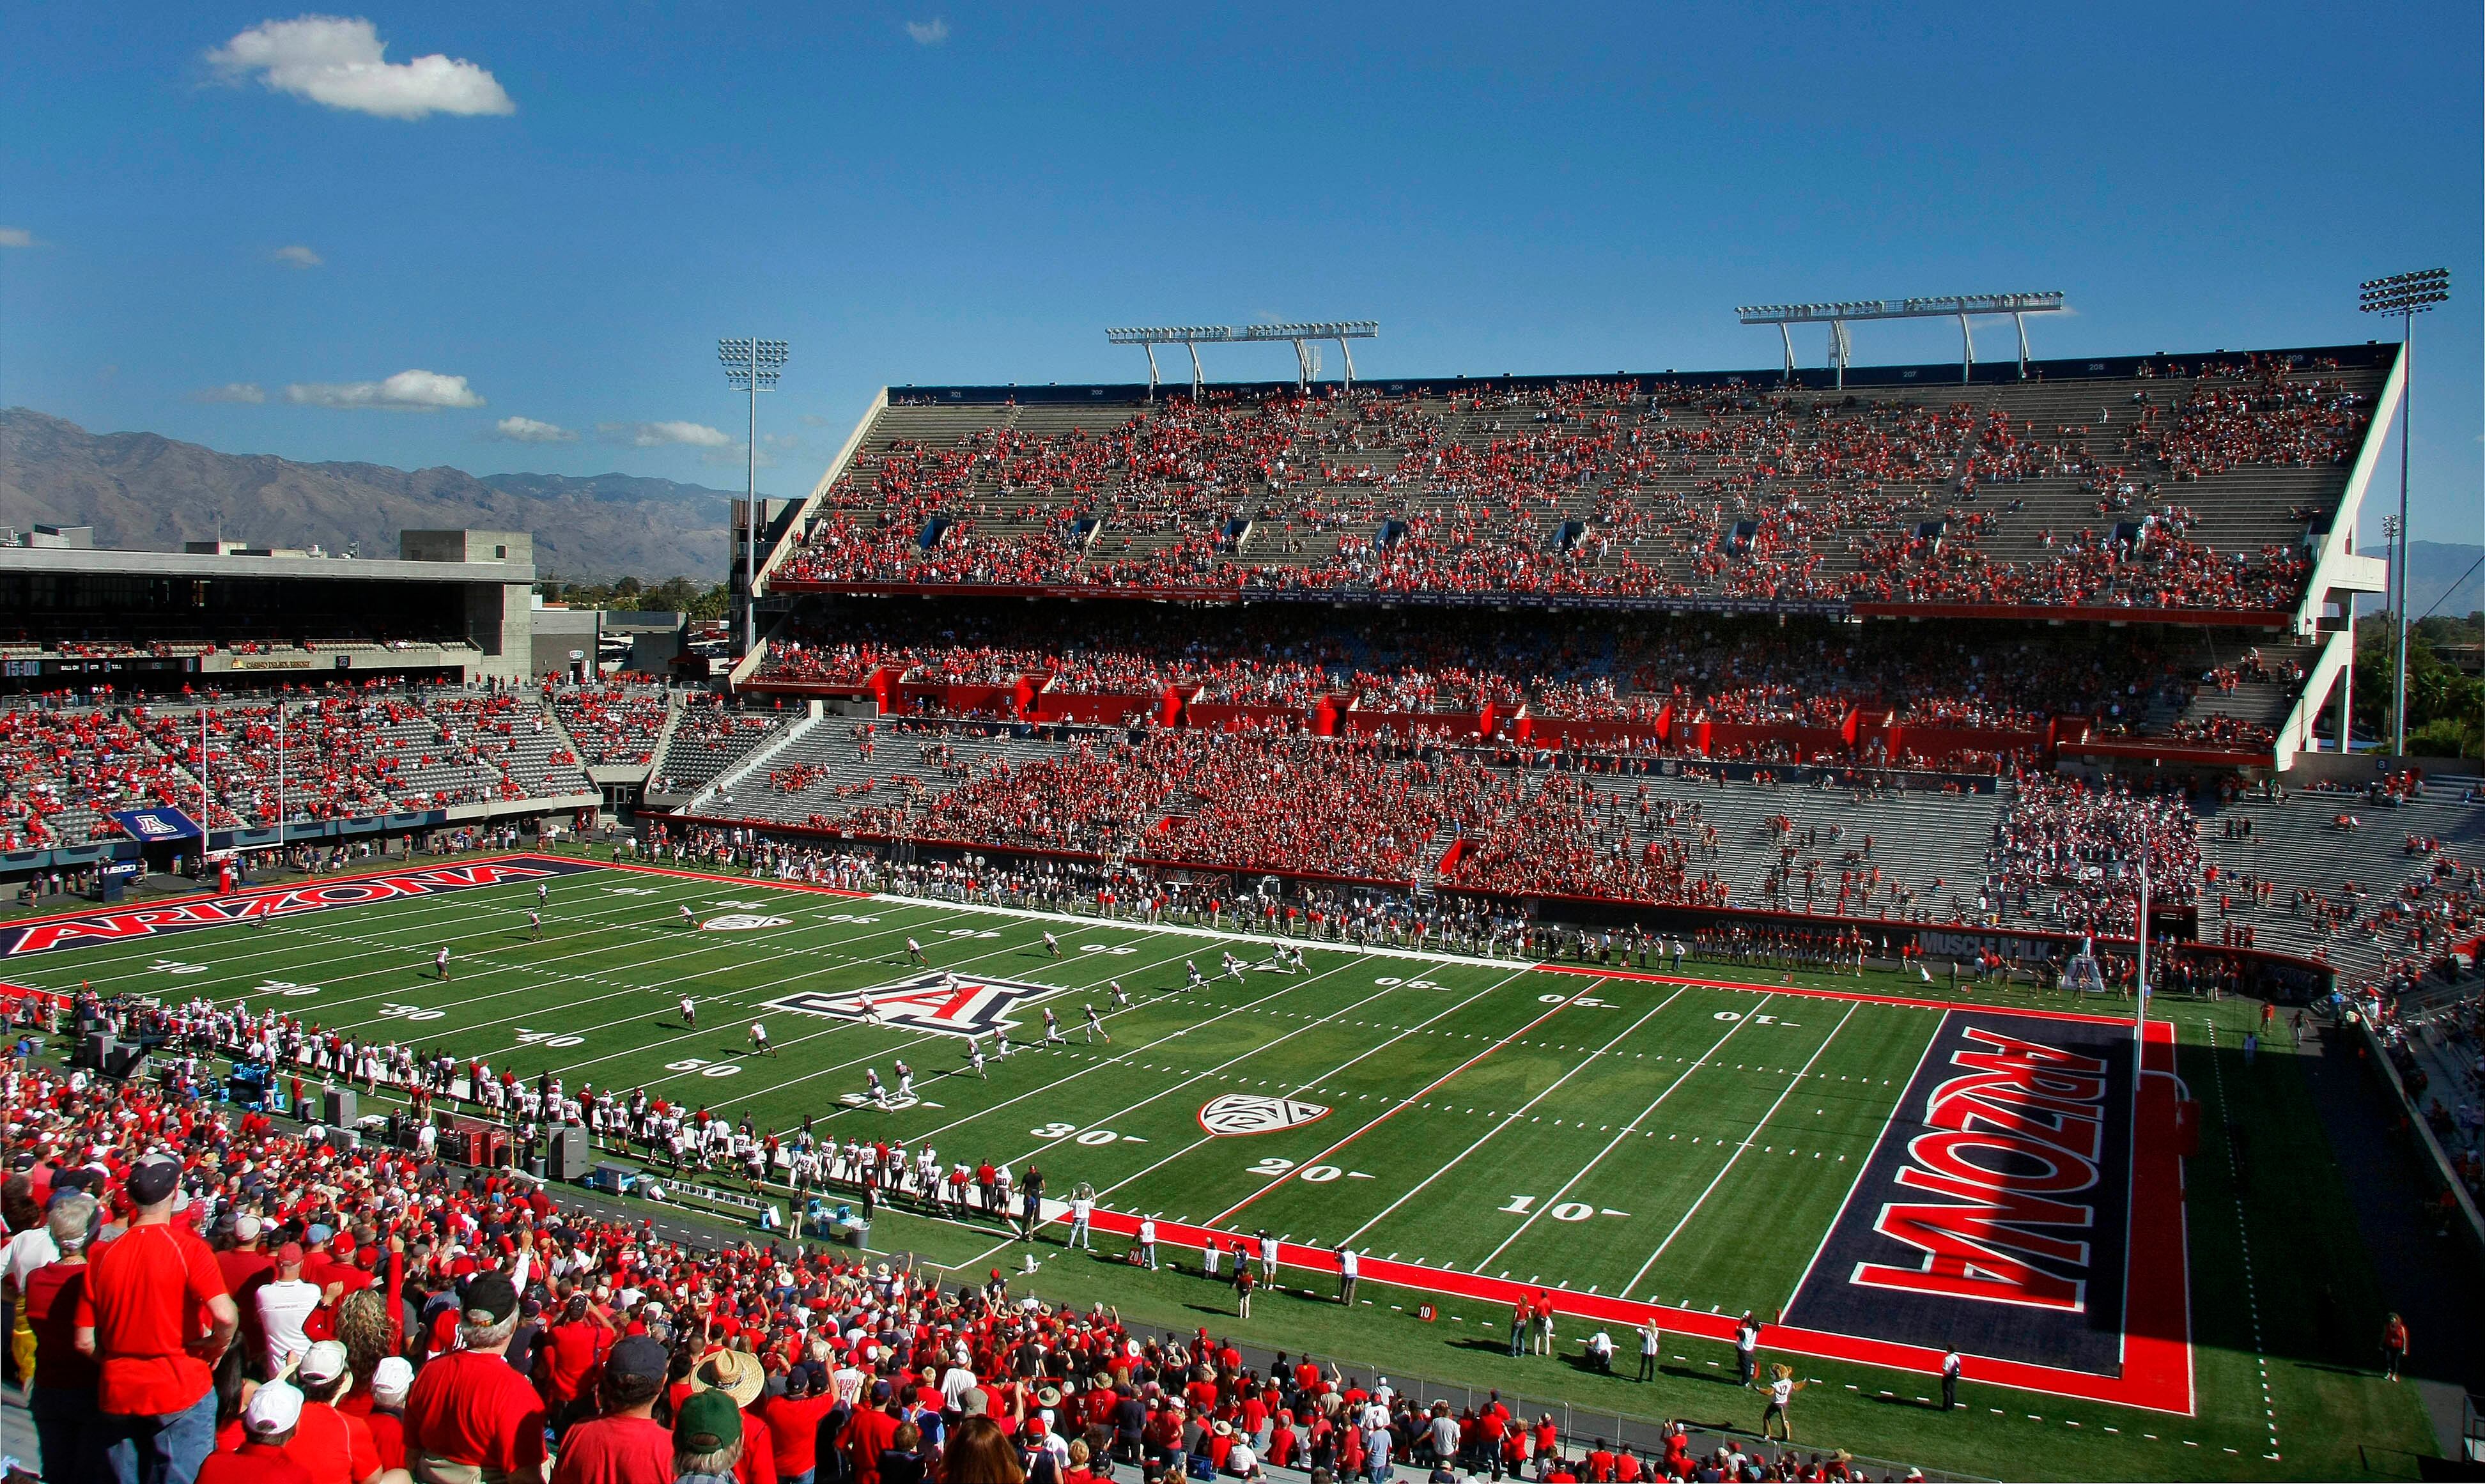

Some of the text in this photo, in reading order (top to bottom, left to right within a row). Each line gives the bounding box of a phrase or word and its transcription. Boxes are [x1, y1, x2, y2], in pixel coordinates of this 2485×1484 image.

[5, 661, 40, 676] 15:00
[339, 657, 348, 666] 25
[134, 814, 178, 834] A
[821, 840, 833, 850] DEL
[853, 844, 885, 856] RESORT
[9, 864, 559, 954] ARIZONA
[715, 900, 767, 909] 20
[828, 915, 880, 924] 30
[948, 929, 1000, 938] 40
[1079, 944, 1138, 955] 50
[1919, 931, 1995, 957] MUSCLE
[254, 982, 320, 996] 20
[1374, 977, 1437, 989] 30
[759, 971, 1066, 1038] A
[1538, 994, 1605, 1008] 20
[378, 1005, 446, 1021] 30
[1713, 1011, 1778, 1024] 10
[515, 1032, 585, 1047] 40
[665, 1059, 742, 1077] 50
[1030, 1122, 1118, 1145] 30
[1246, 1158, 1342, 1182] 20
[1849, 1025, 2107, 1313] ARIZONA
[1498, 1194, 1594, 1221] 10
[1129, 1250, 1140, 1262] 20
[1420, 1306, 1431, 1318] 10
